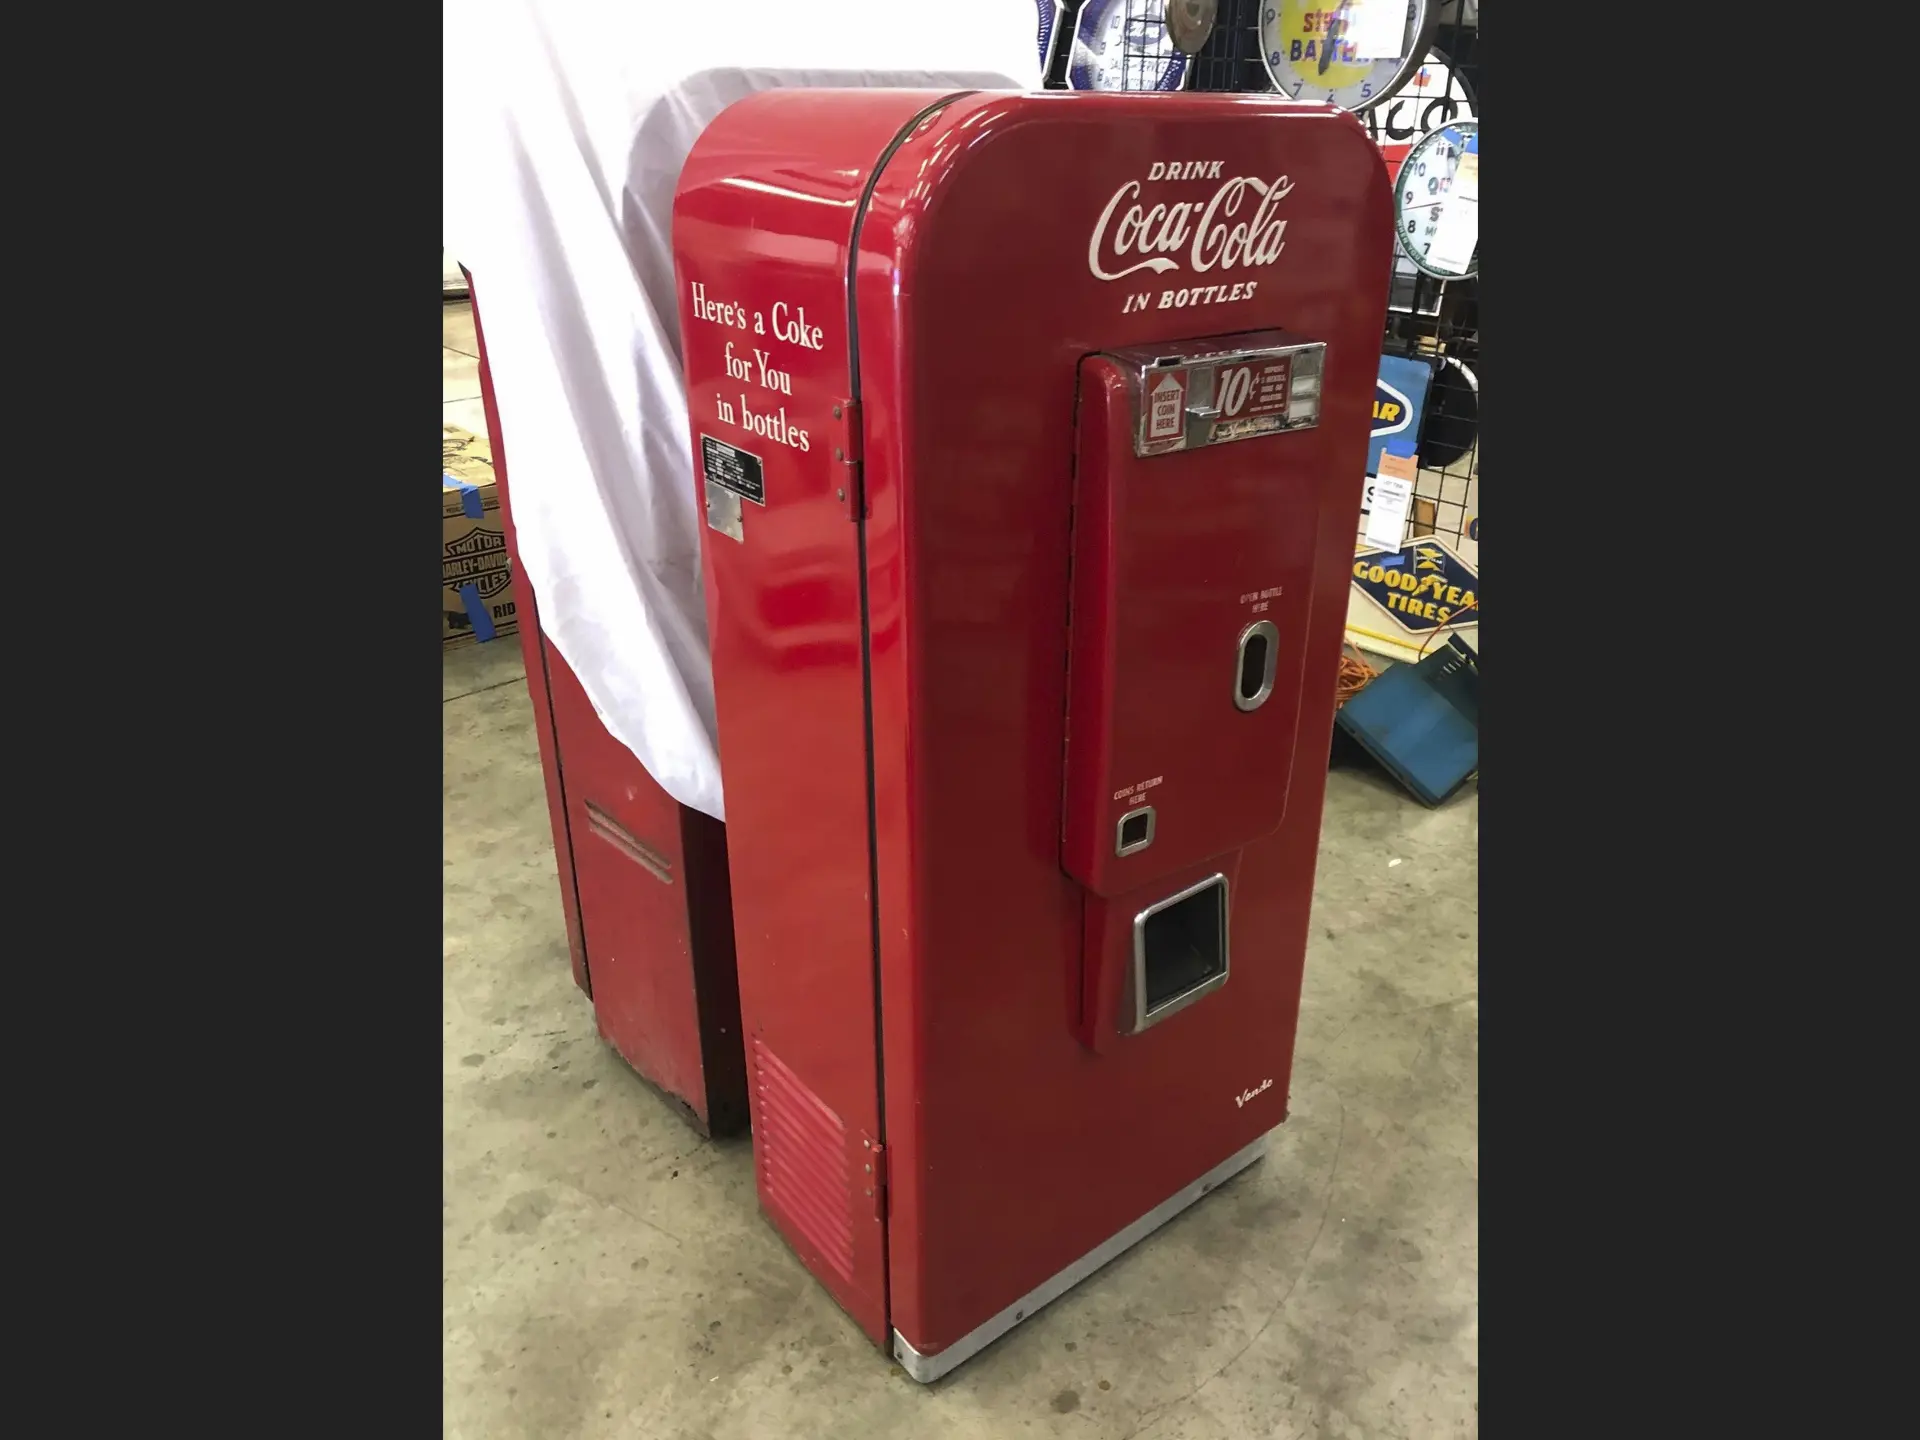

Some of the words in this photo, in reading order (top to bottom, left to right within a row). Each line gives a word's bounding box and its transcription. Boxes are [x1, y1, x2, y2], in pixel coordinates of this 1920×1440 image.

[1265, 8, 1276, 26] 9
[1270, 51, 1281, 67] 8
[1292, 83, 1304, 98] 7
[1360, 83, 1372, 98] 5
[1147, 160, 1225, 181] DRINK
[1413, 162, 1427, 178] 10
[1405, 191, 1414, 205] 9
[1088, 174, 1296, 281] Coca-Cola
[1407, 219, 1417, 234] 8
[1423, 242, 1432, 256] 7
[1122, 292, 1151, 314] IN
[1157, 281, 1258, 310] BOTTLES
[691, 281, 747, 330] Here's
[753, 311, 766, 335] a
[772, 301, 824, 350] Coke
[725, 341, 752, 383] for
[753, 348, 792, 396] You
[1154, 389, 1180, 403] INSERT
[1157, 403, 1176, 416] COIN
[716, 393, 735, 425] in
[740, 393, 810, 452] bottles
[1156, 417, 1175, 430] HERE
[456, 534, 502, 554] MOTOR
[1387, 591, 1451, 623] TIRES
[1113, 785, 1135, 800] COINS
[1136, 775, 1164, 792] RETURN
[1128, 791, 1147, 806] HERE
